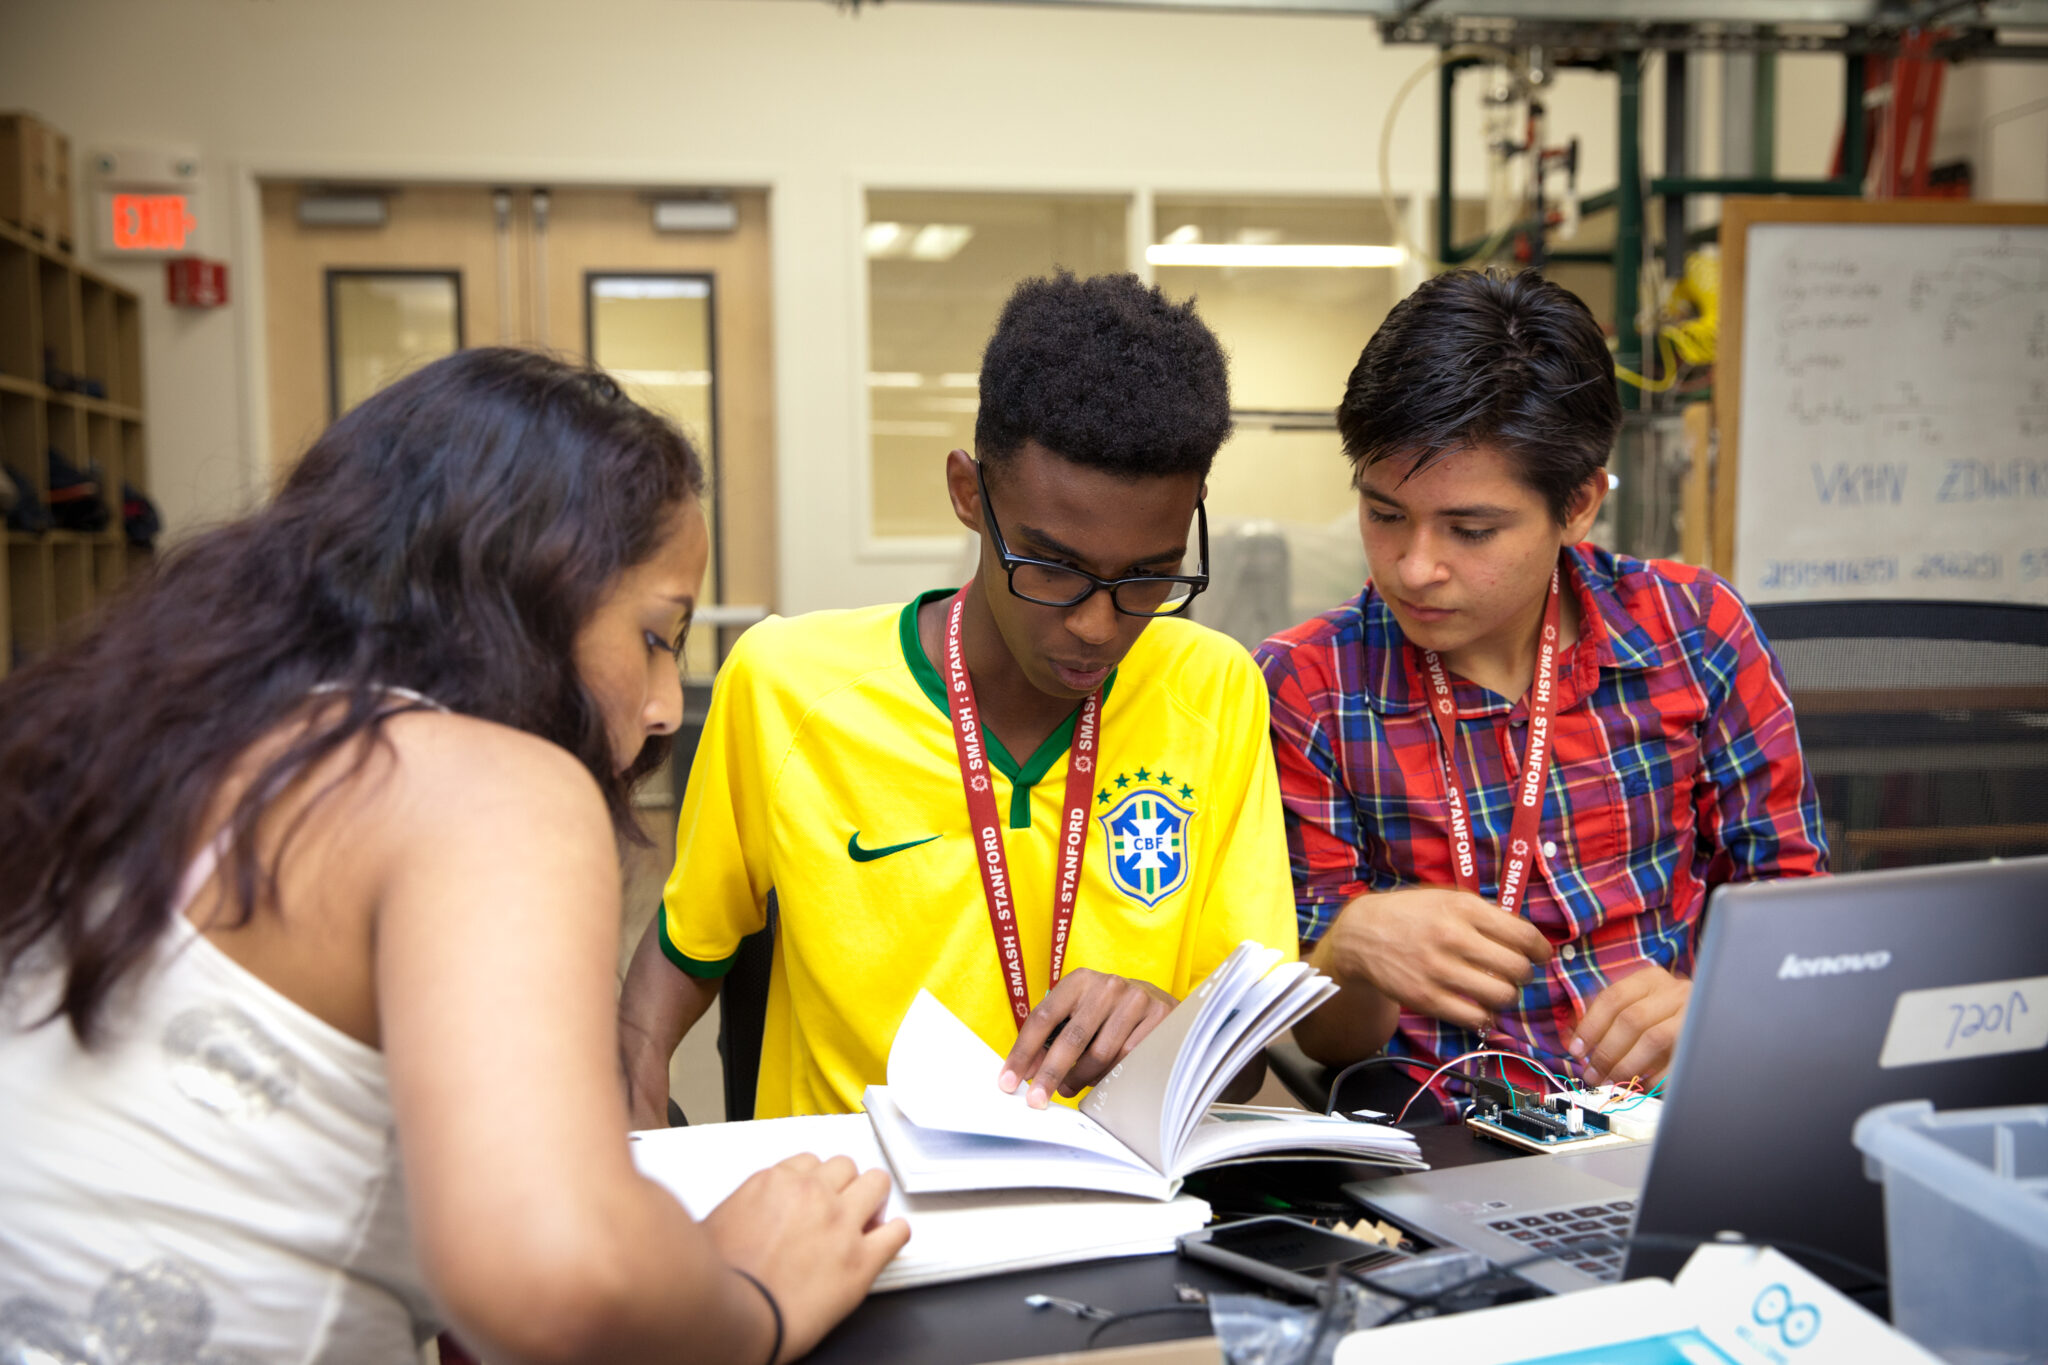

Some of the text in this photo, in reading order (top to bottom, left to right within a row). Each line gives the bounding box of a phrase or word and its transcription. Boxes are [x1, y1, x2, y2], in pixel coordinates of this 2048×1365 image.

[112, 194, 186, 250] EXIT
[950, 601, 967, 692] STANFORD
[1537, 644, 1553, 702] SMASH
[959, 707, 983, 770] SMASH
[1523, 716, 1548, 807] STANFORD
[1133, 837, 1163, 850] CBF
[1448, 787, 1474, 877] STANFORD
[982, 826, 1011, 920] STANFORD
[1053, 919, 1068, 980] SMASH
[1062, 807, 1084, 902] STANFORD
[1003, 936, 1024, 997] SMASH
[1777, 951, 1892, 980] lenovo
